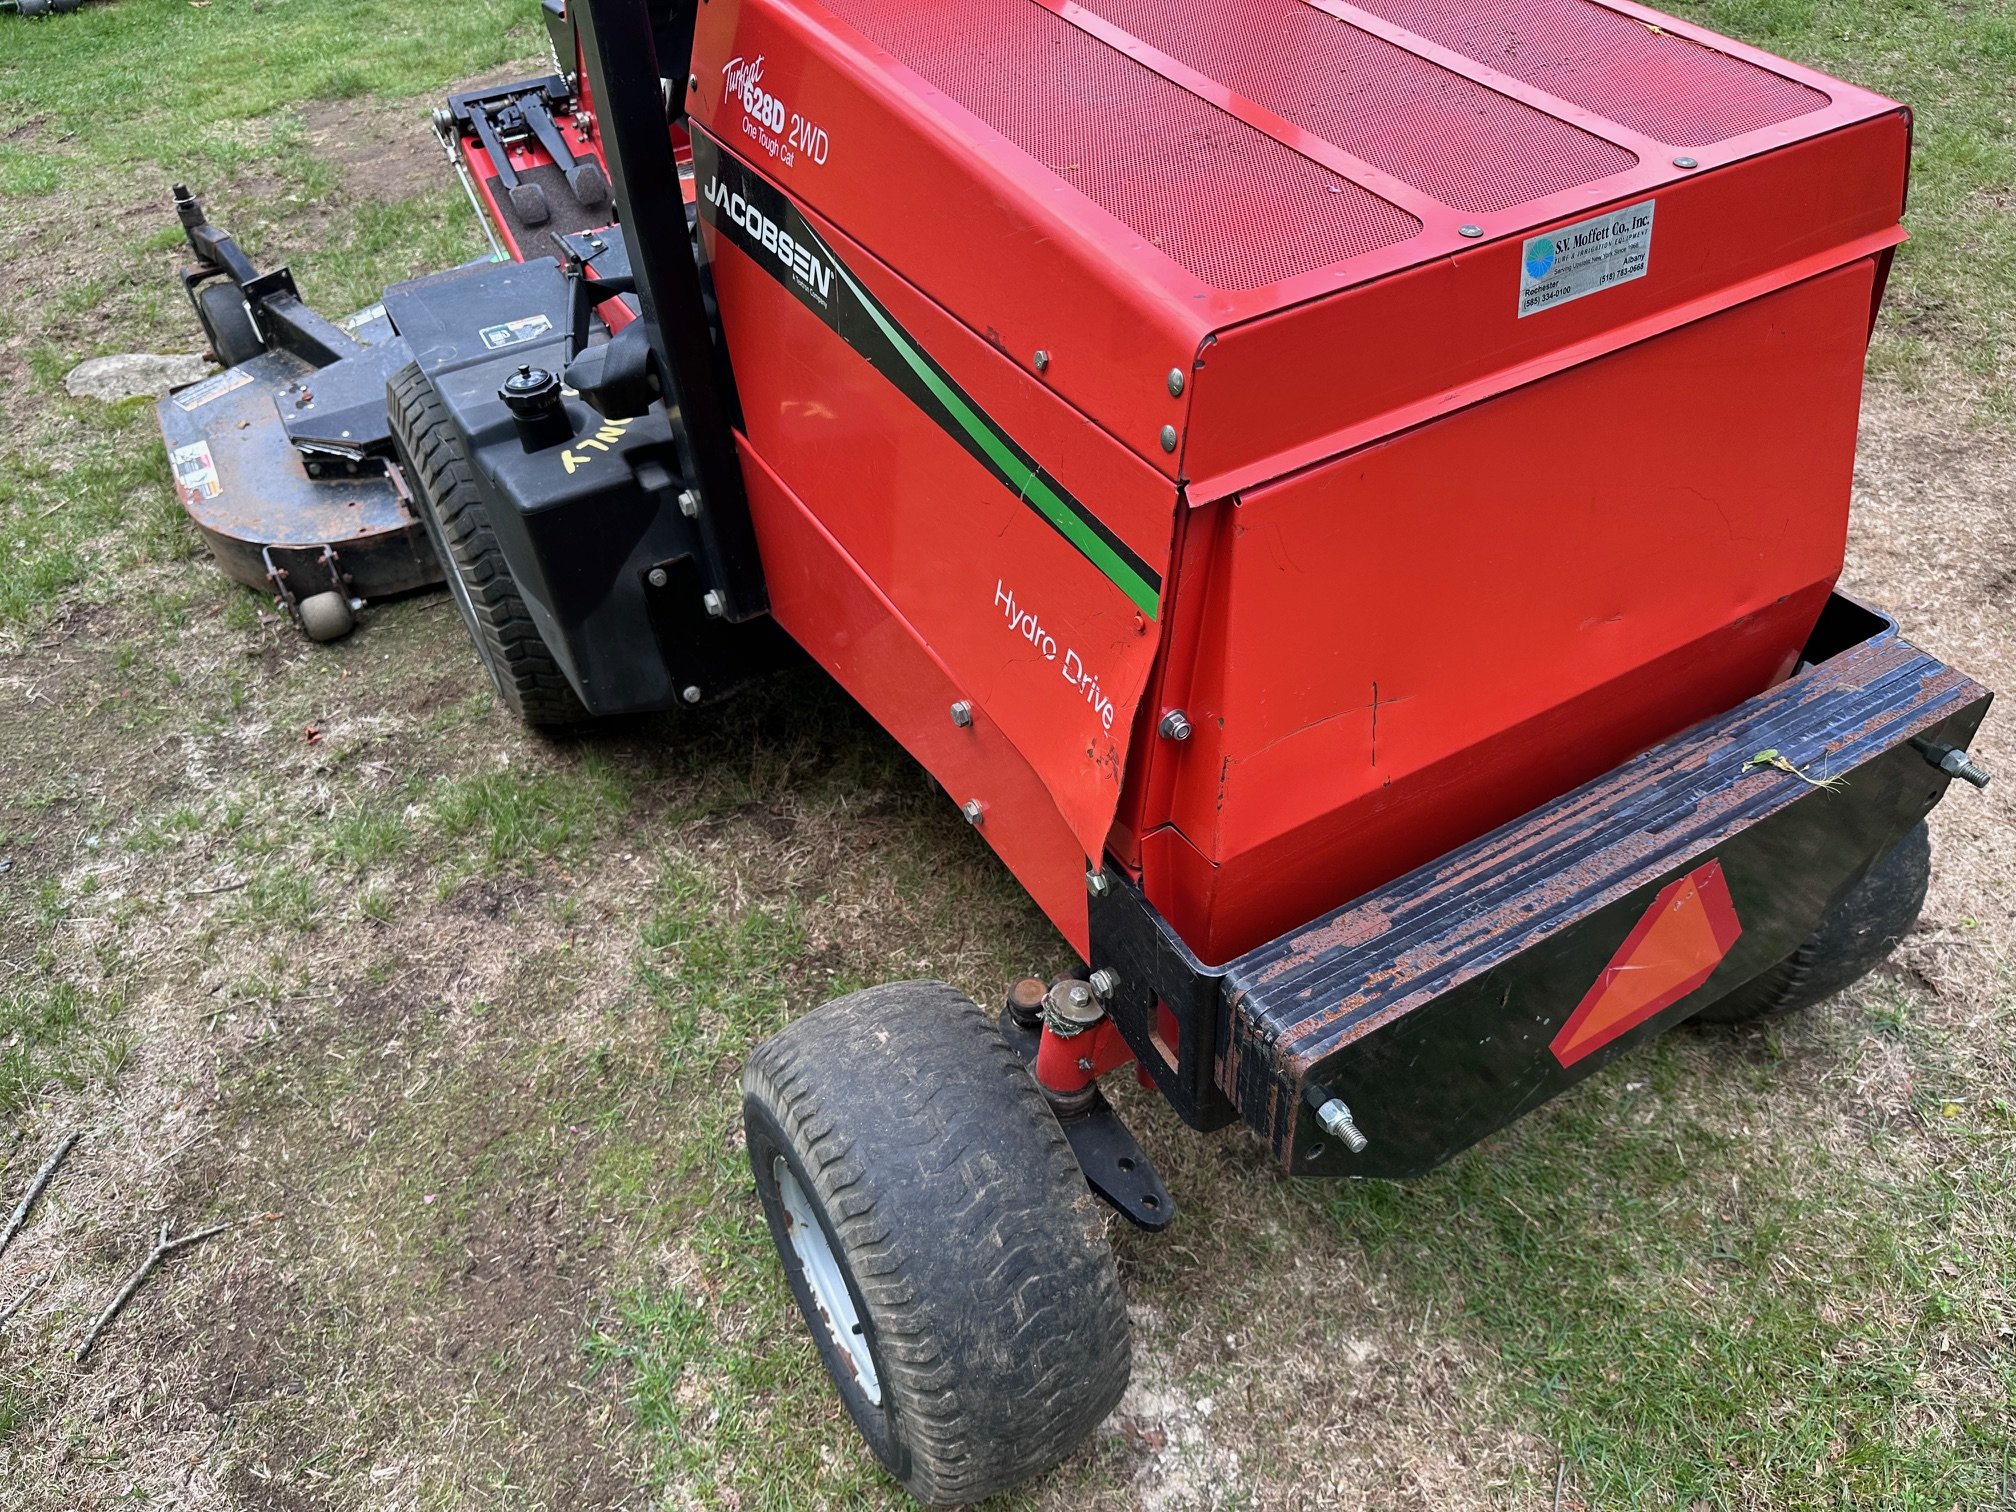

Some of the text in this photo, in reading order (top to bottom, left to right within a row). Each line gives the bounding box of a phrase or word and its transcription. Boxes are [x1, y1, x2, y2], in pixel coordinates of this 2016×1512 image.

[722, 54, 764, 104] Turfcat
[743, 80, 829, 165] 628D 2WD
[742, 116, 794, 168] One Tough Cat
[704, 175, 831, 299] JACOBSEN
[1554, 254, 1569, 265] TURF
[1577, 241, 1612, 257] IRRIGATION
[1614, 229, 1648, 245] EQUIPMENT
[1555, 216, 1650, 255] S.V. Moffett Co., Inc.
[1554, 265, 1572, 276] Serving
[1623, 253, 1646, 265] Albany
[1525, 280, 1559, 297] Rochester
[1600, 272, 1615, 285] (518)
[1523, 286, 1571, 309] (585) 334-0100
[994, 578, 1114, 730] Hydro Drive
